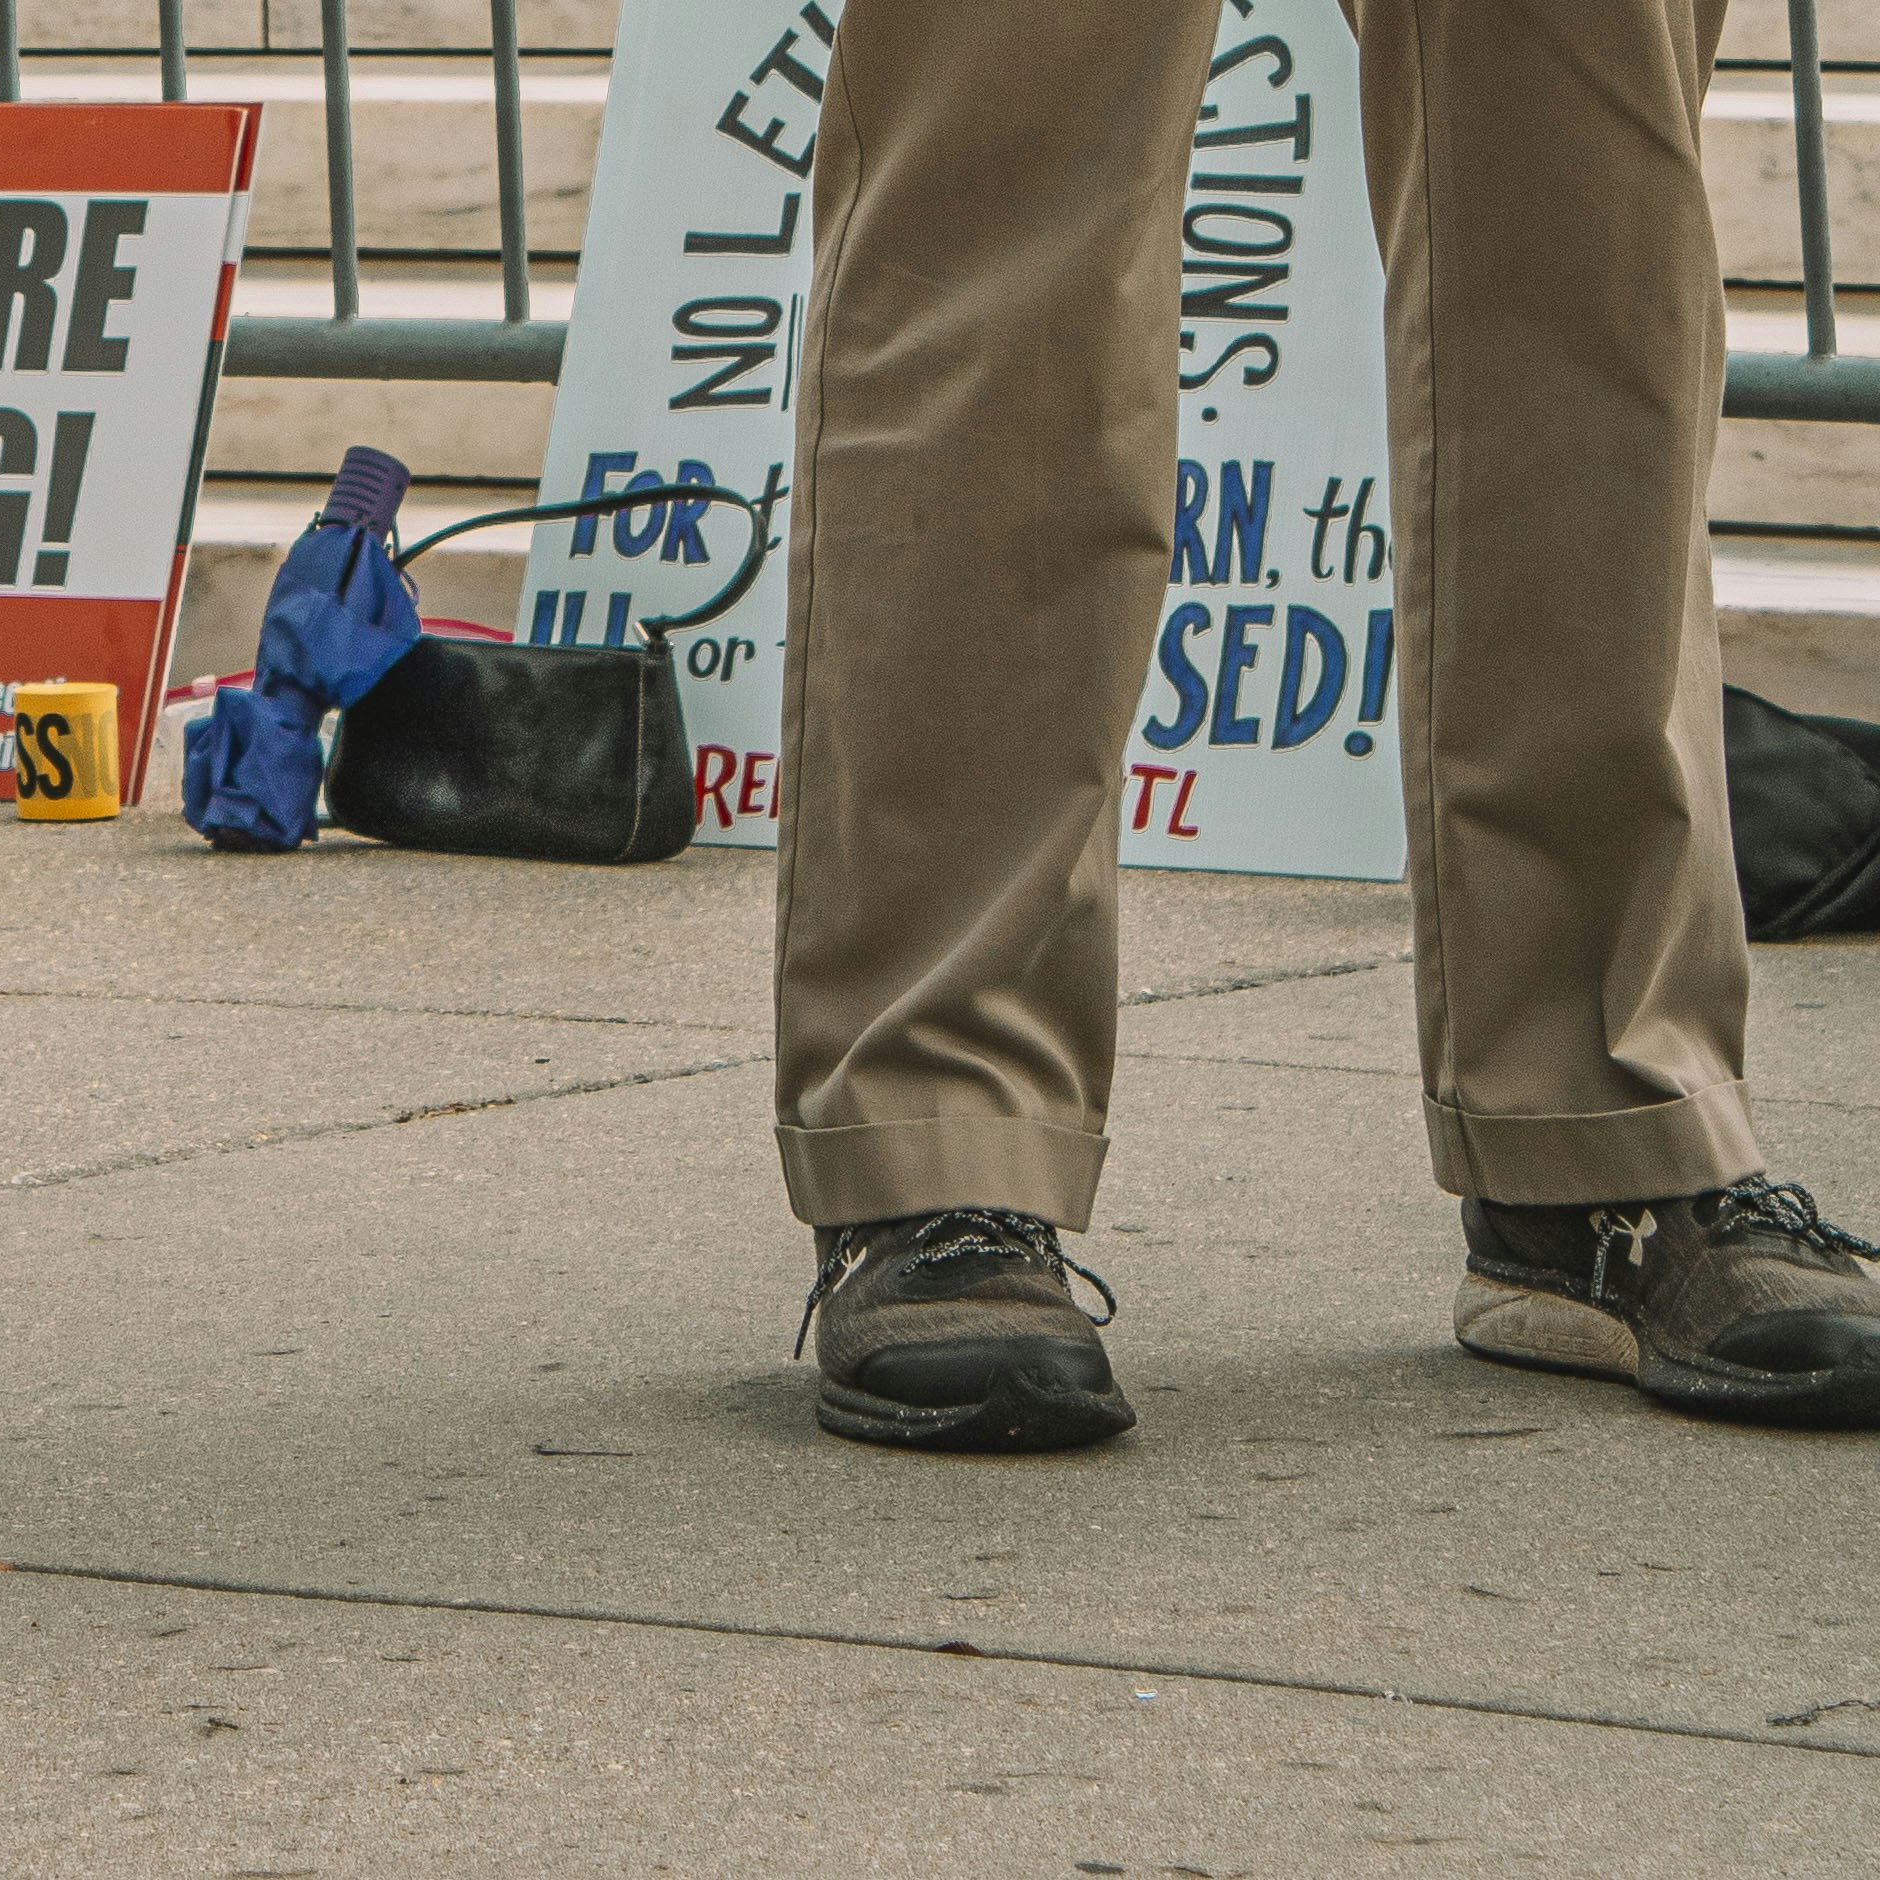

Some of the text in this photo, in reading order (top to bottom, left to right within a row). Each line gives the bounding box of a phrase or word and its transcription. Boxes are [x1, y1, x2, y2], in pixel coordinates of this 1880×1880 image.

[668, 295, 784, 411] NO
[570, 451, 716, 565] FOR
[1302, 476, 1394, 585] th
[686, 636, 756, 683] or
